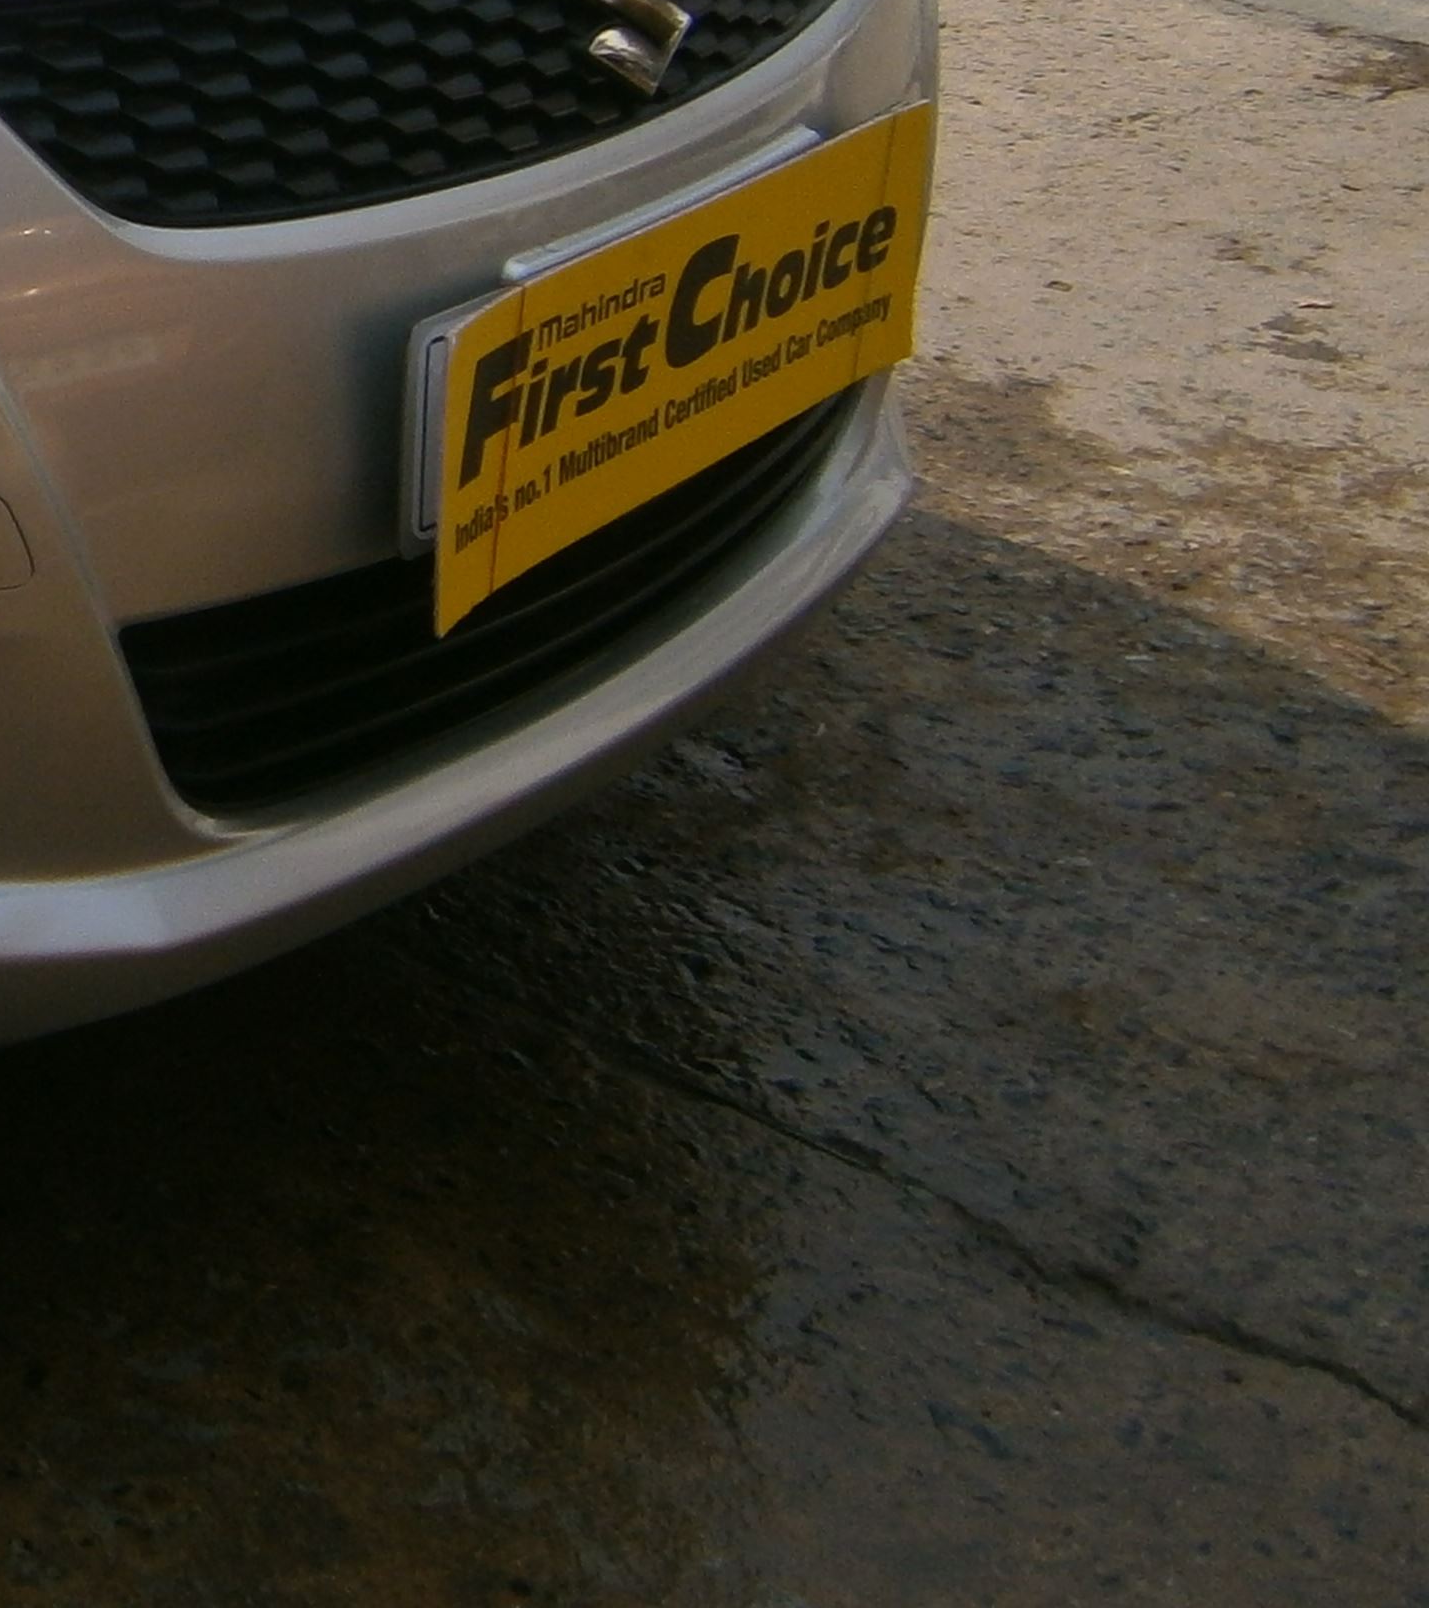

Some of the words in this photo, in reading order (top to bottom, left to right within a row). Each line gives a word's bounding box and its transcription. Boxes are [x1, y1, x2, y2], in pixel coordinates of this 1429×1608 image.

[458, 314, 661, 491] First
[665, 206, 897, 368] Choice
[537, 273, 666, 351] Mahindra
[559, 407, 659, 487] Multibrand
[665, 366, 737, 429] Certified
[742, 343, 782, 388] Used
[786, 332, 814, 365] Car
[817, 293, 892, 347] Company
